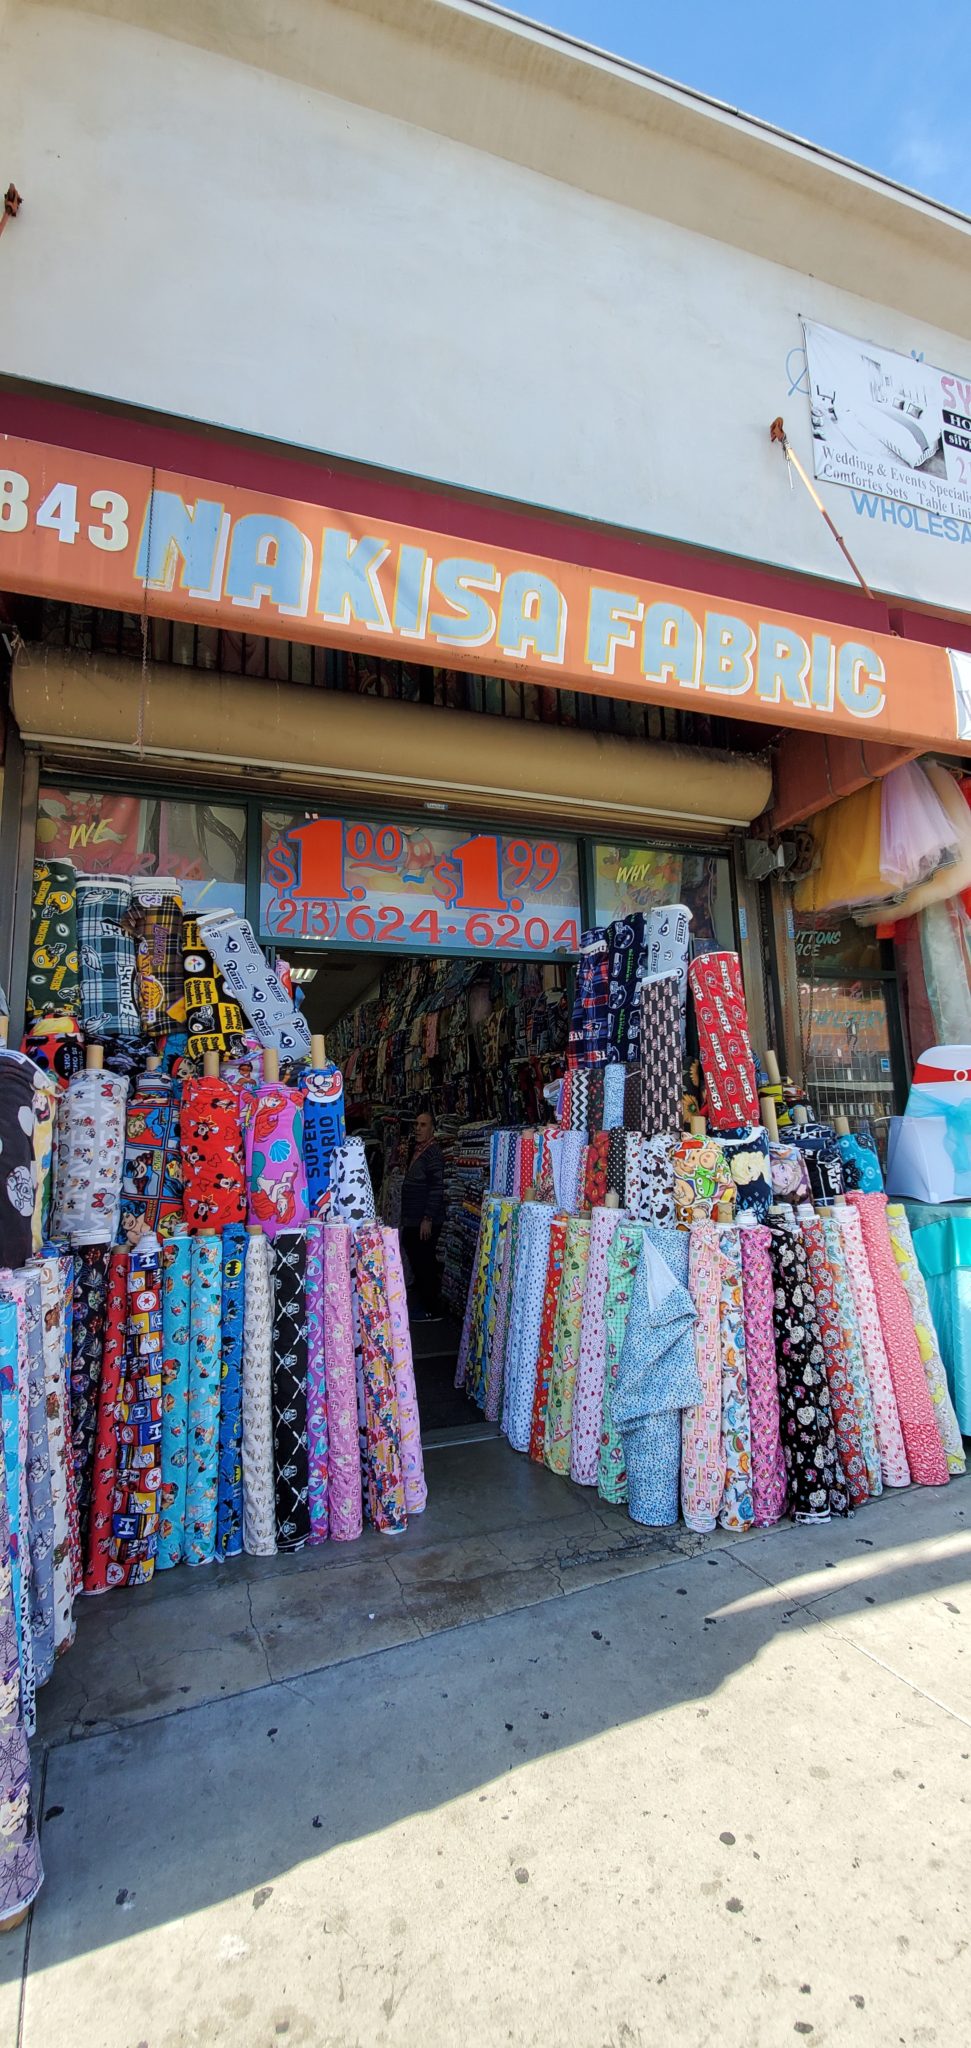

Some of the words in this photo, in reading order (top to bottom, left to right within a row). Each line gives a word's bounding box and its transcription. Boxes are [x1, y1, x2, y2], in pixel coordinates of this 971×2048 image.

[822, 445, 874, 475] Wedding
[876, 463, 887, 477] &
[891, 466, 927, 489] Events
[929, 479, 971, 503] Speciali
[850, 490, 971, 544] WHOLESA
[886, 483, 909, 500] Sets
[917, 492, 948, 514] Table
[0, 469, 129, 552] 843
[133, 489, 568, 664] NAKISA
[584, 586, 886, 719] FABRIC
[69, 818, 113, 850] WE
[34, 880, 52, 906] PACKERS
[616, 863, 651, 884] WHY
[34, 919, 50, 946] PACKERS
[240, 921, 261, 955] Rams
[266, 897, 341, 940] (213)
[675, 912, 688, 944] Rams
[50, 965, 67, 991] PACKERS
[118, 964, 134, 1018] EAGLES
[223, 959, 246, 991] Rams
[265, 974, 286, 1003] Rams
[719, 960, 736, 999] 49ERS
[714, 995, 732, 1034] 49ERS
[709, 1032, 728, 1072] 49ERS
[705, 1071, 723, 1111] 49ERS
[737, 1064, 754, 1104] 49ERS
[303, 1118, 320, 1179] SUPER
